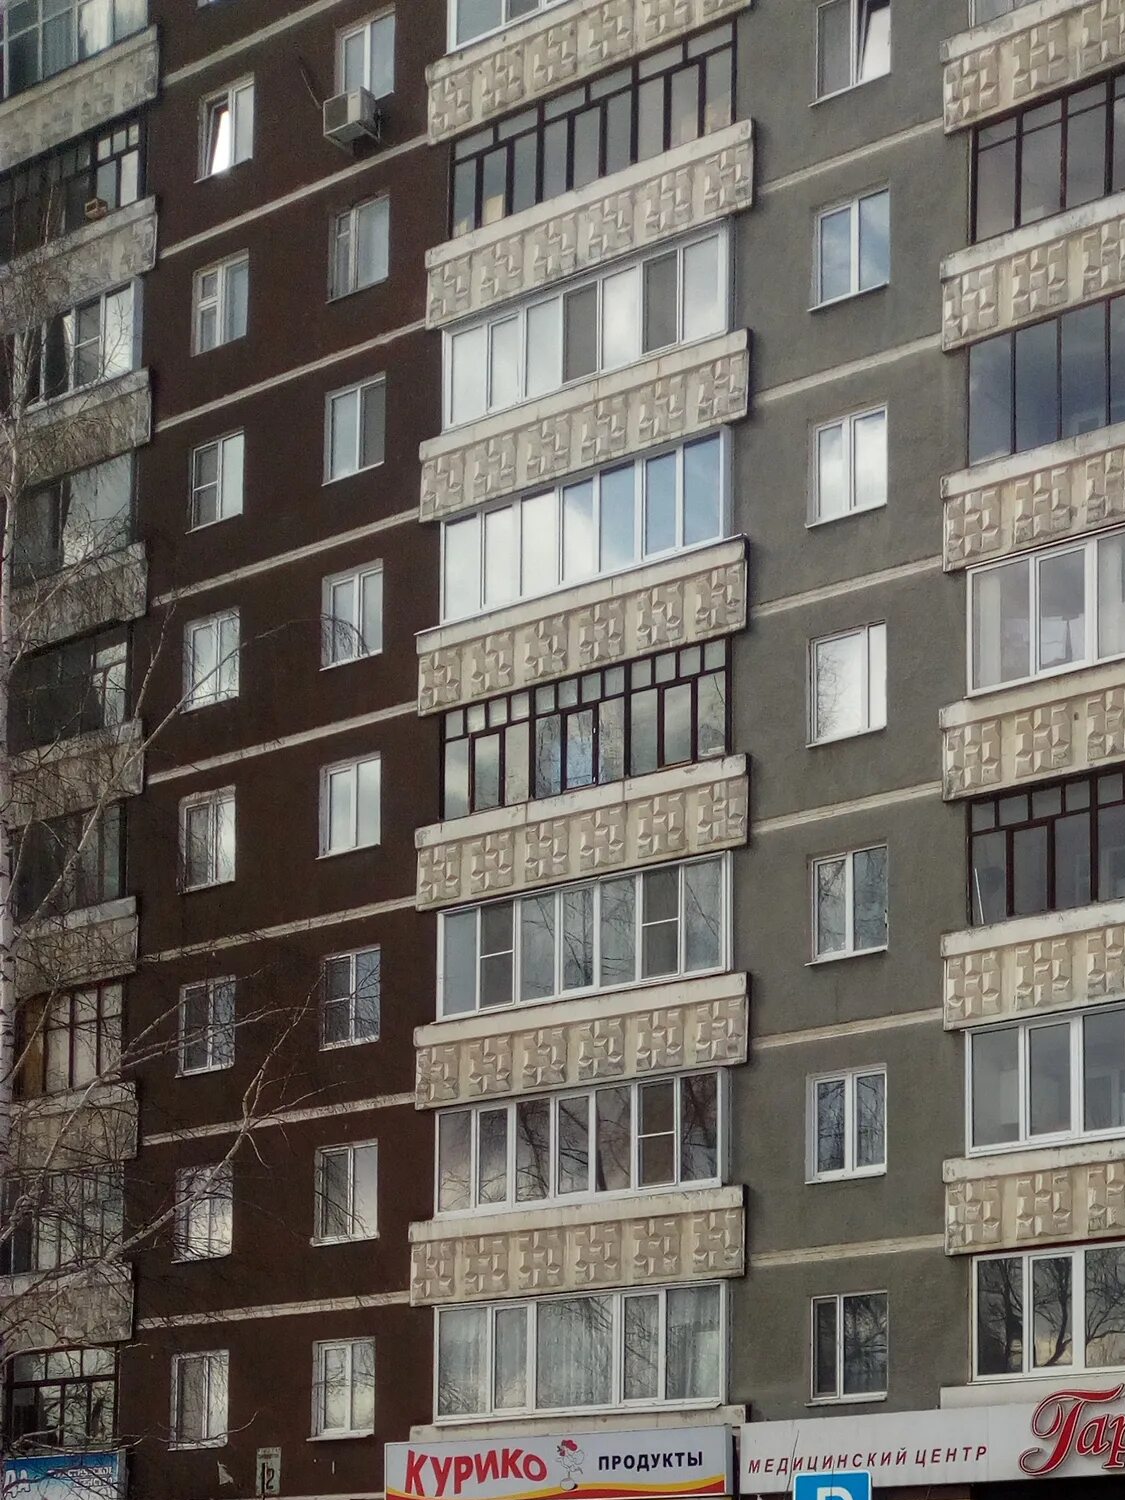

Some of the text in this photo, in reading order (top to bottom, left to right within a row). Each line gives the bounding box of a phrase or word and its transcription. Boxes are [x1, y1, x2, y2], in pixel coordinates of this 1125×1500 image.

[404, 1448, 547, 1497] КУРИКО
[598, 1451, 703, 1472] ПРОДУКТЫ
[749, 1446, 987, 1475] МЕДИЦИНСКИЙ ЦЕНТР
